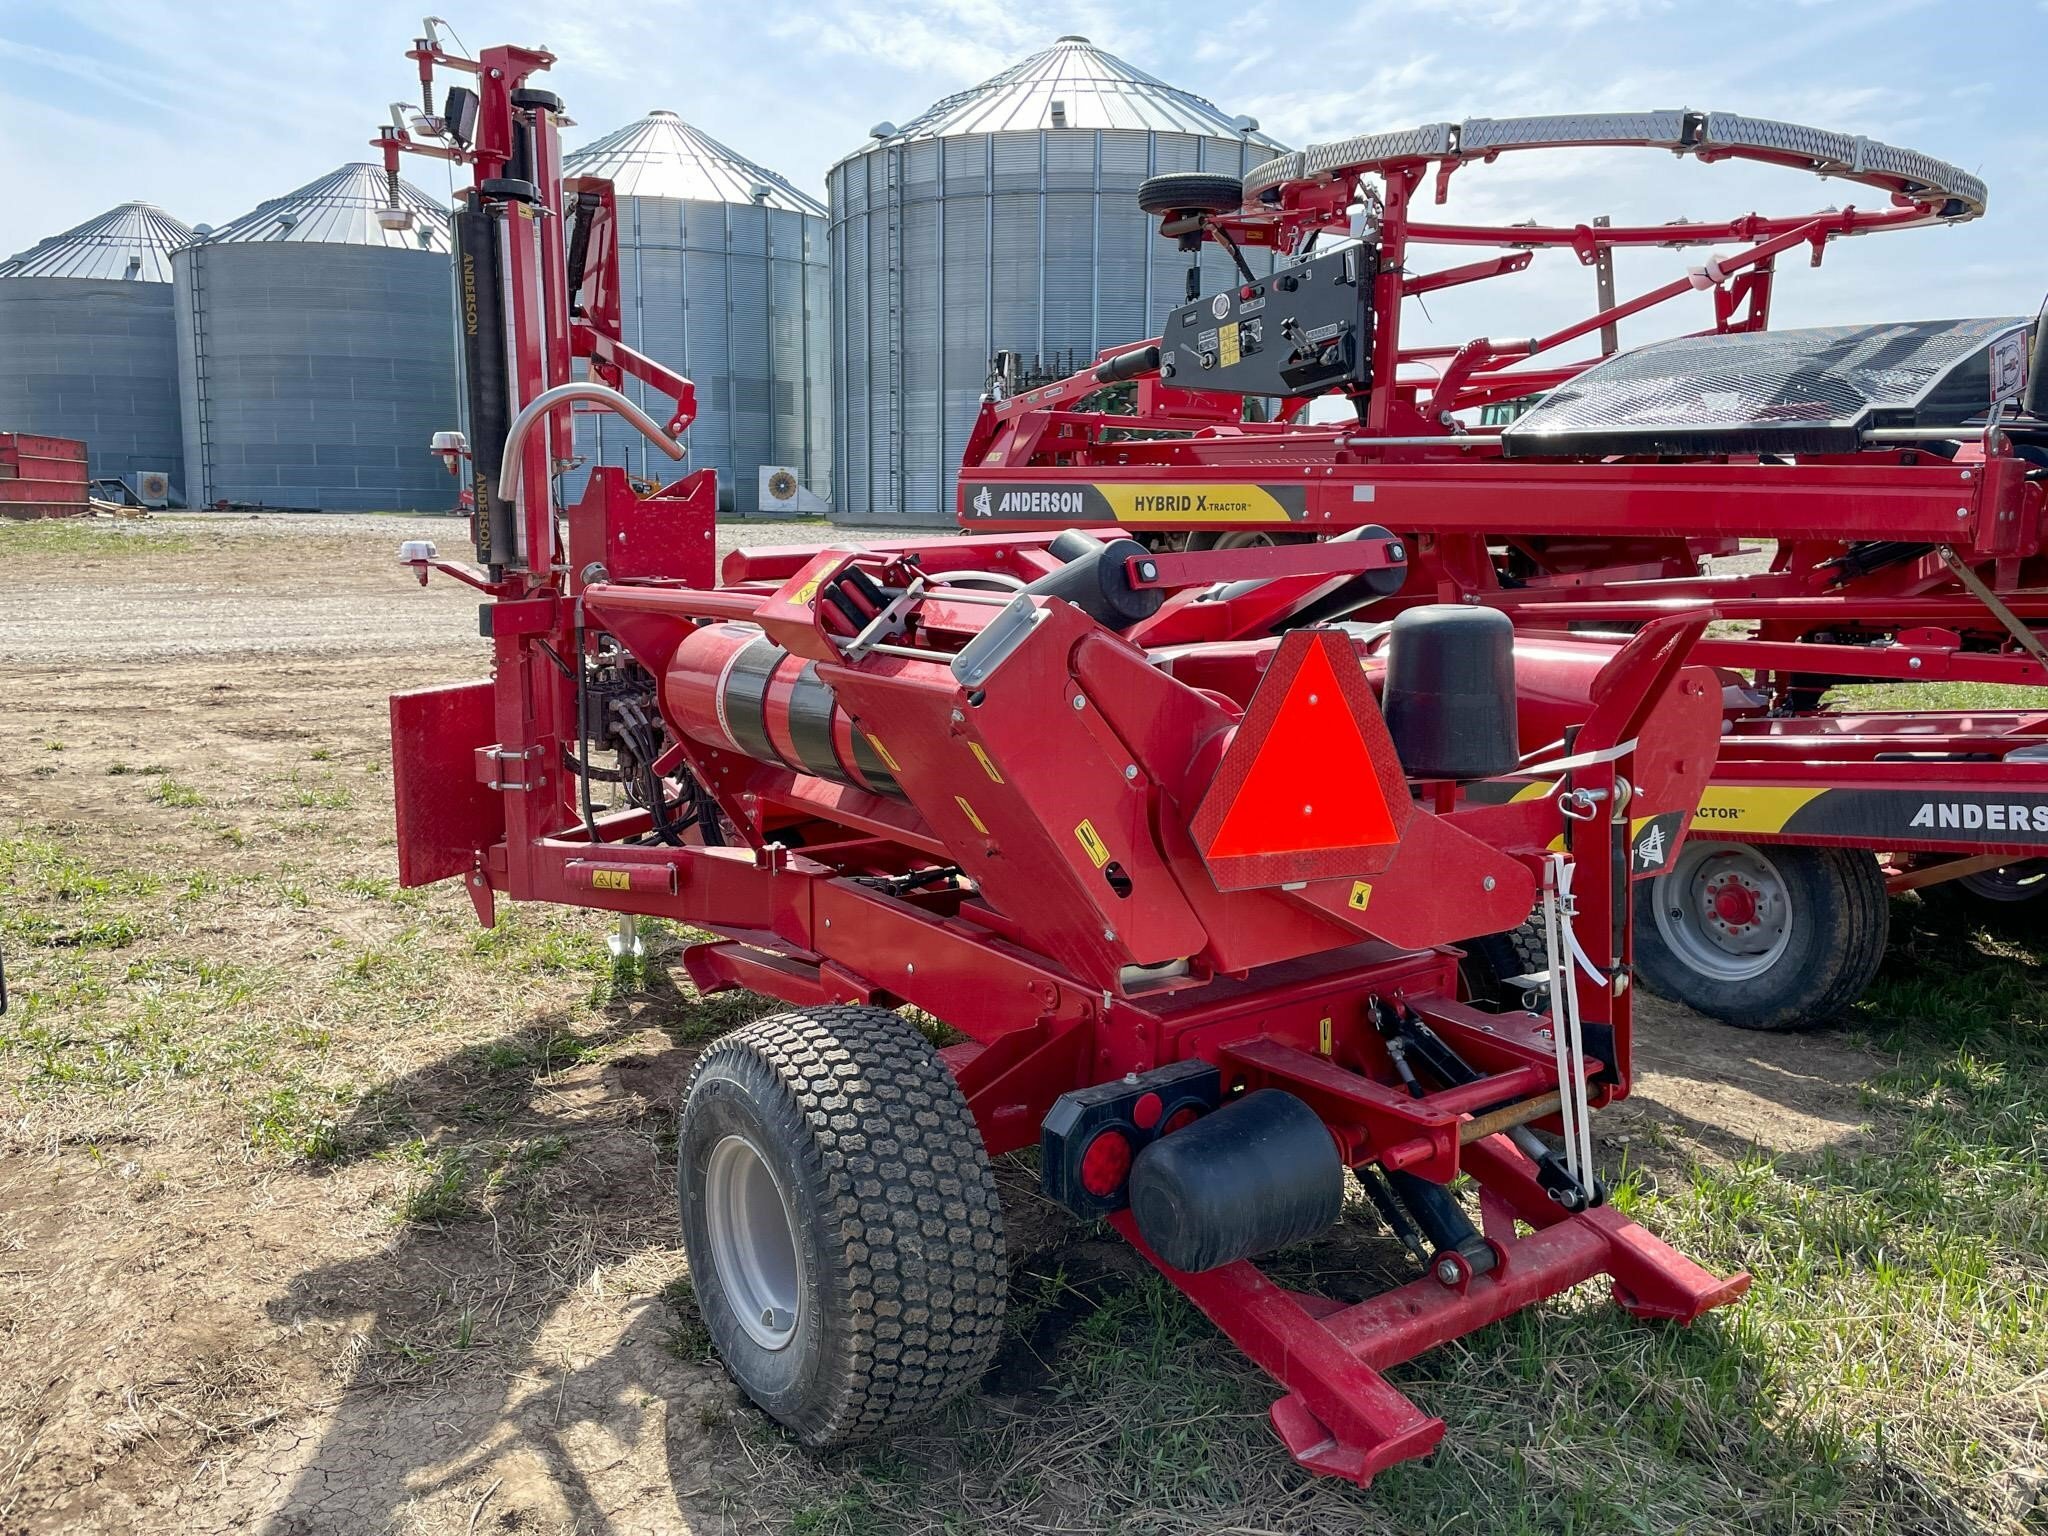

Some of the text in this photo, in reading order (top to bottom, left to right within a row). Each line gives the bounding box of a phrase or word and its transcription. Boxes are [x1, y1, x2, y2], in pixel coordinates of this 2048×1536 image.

[464, 252, 478, 335] ANDERSON
[476, 472, 491, 551] ANDERSON
[999, 492, 1083, 513] ANDERSON
[1135, 495, 1191, 512] HYBRID
